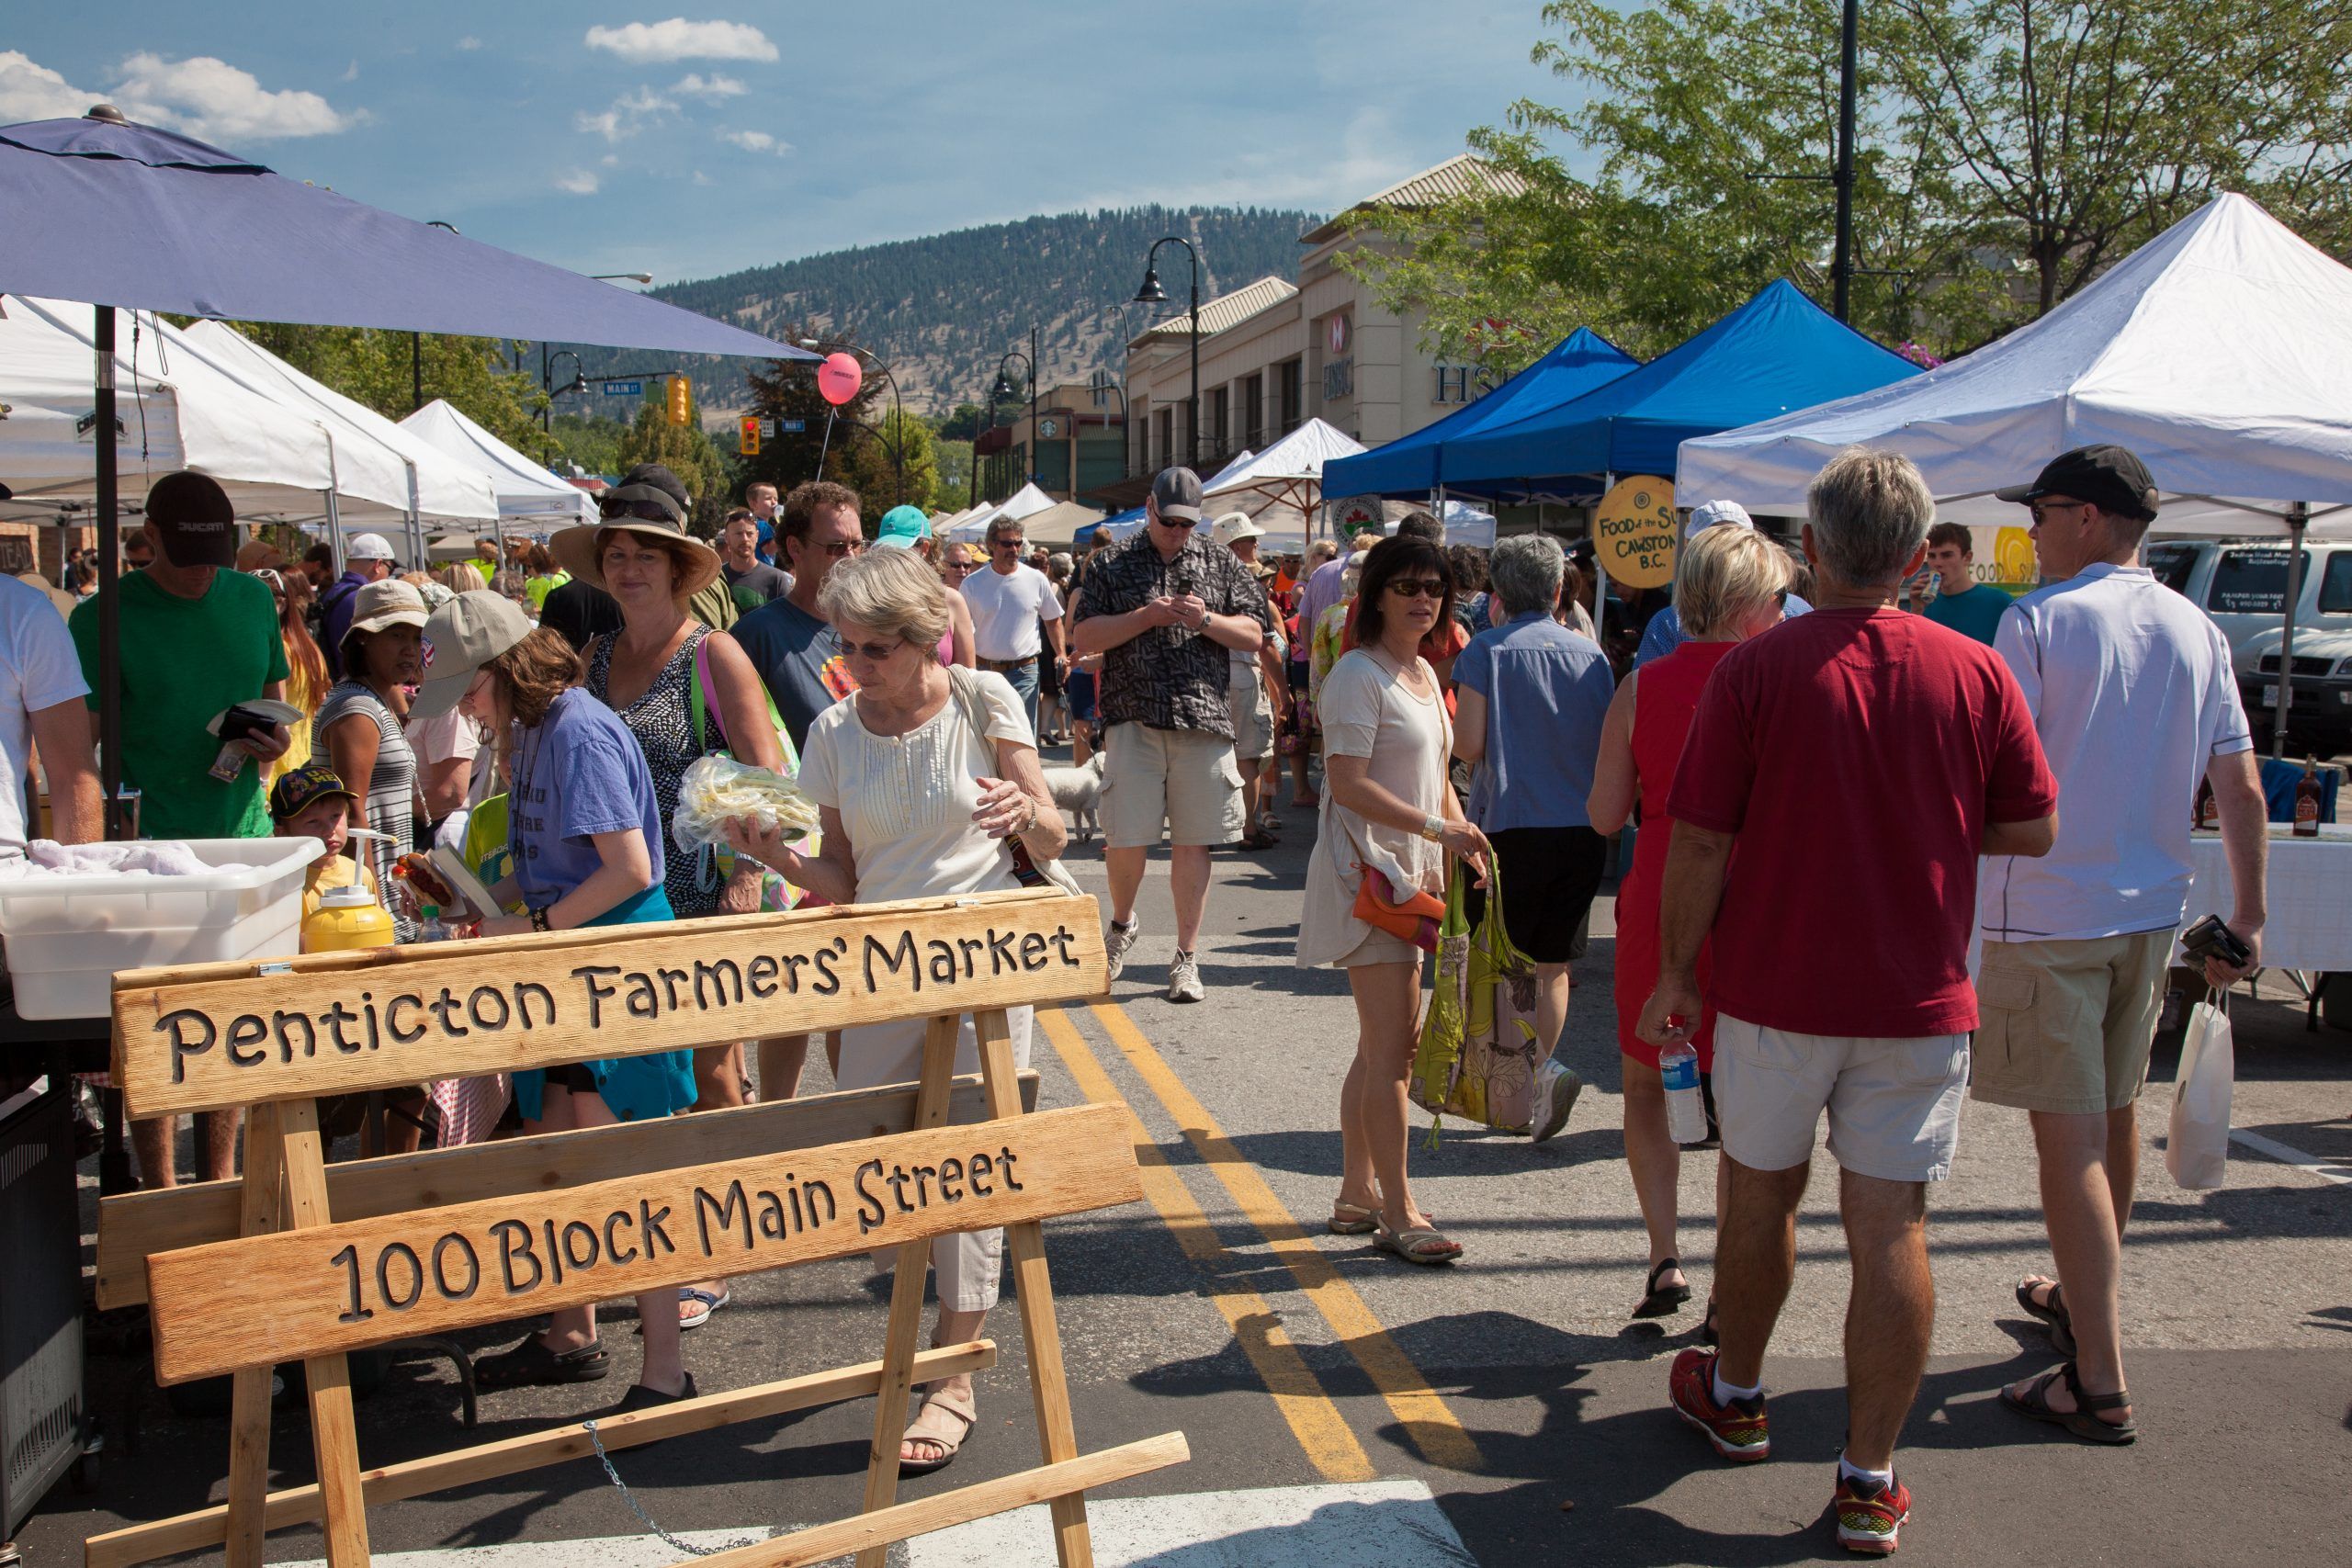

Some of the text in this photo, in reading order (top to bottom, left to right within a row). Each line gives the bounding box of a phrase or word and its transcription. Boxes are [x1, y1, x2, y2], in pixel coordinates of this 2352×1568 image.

[607, 384, 629, 394] MAIN
[1323, 356, 1353, 400] HSBC
[1432, 366, 1510, 404] HS
[177, 521, 225, 533] DUCATI
[1599, 517, 1635, 538] FOOD
[1645, 518, 1657, 528] the
[1657, 506, 1677, 529] SU
[1615, 535, 1676, 558] CAWSTON
[1639, 553, 1667, 570] B.C.
[1967, 562, 2004, 582] FOOD
[155, 979, 557, 1084] Penticton
[862, 924, 1081, 994] Market
[330, 1145, 1024, 1324] 100 Block Main Street
